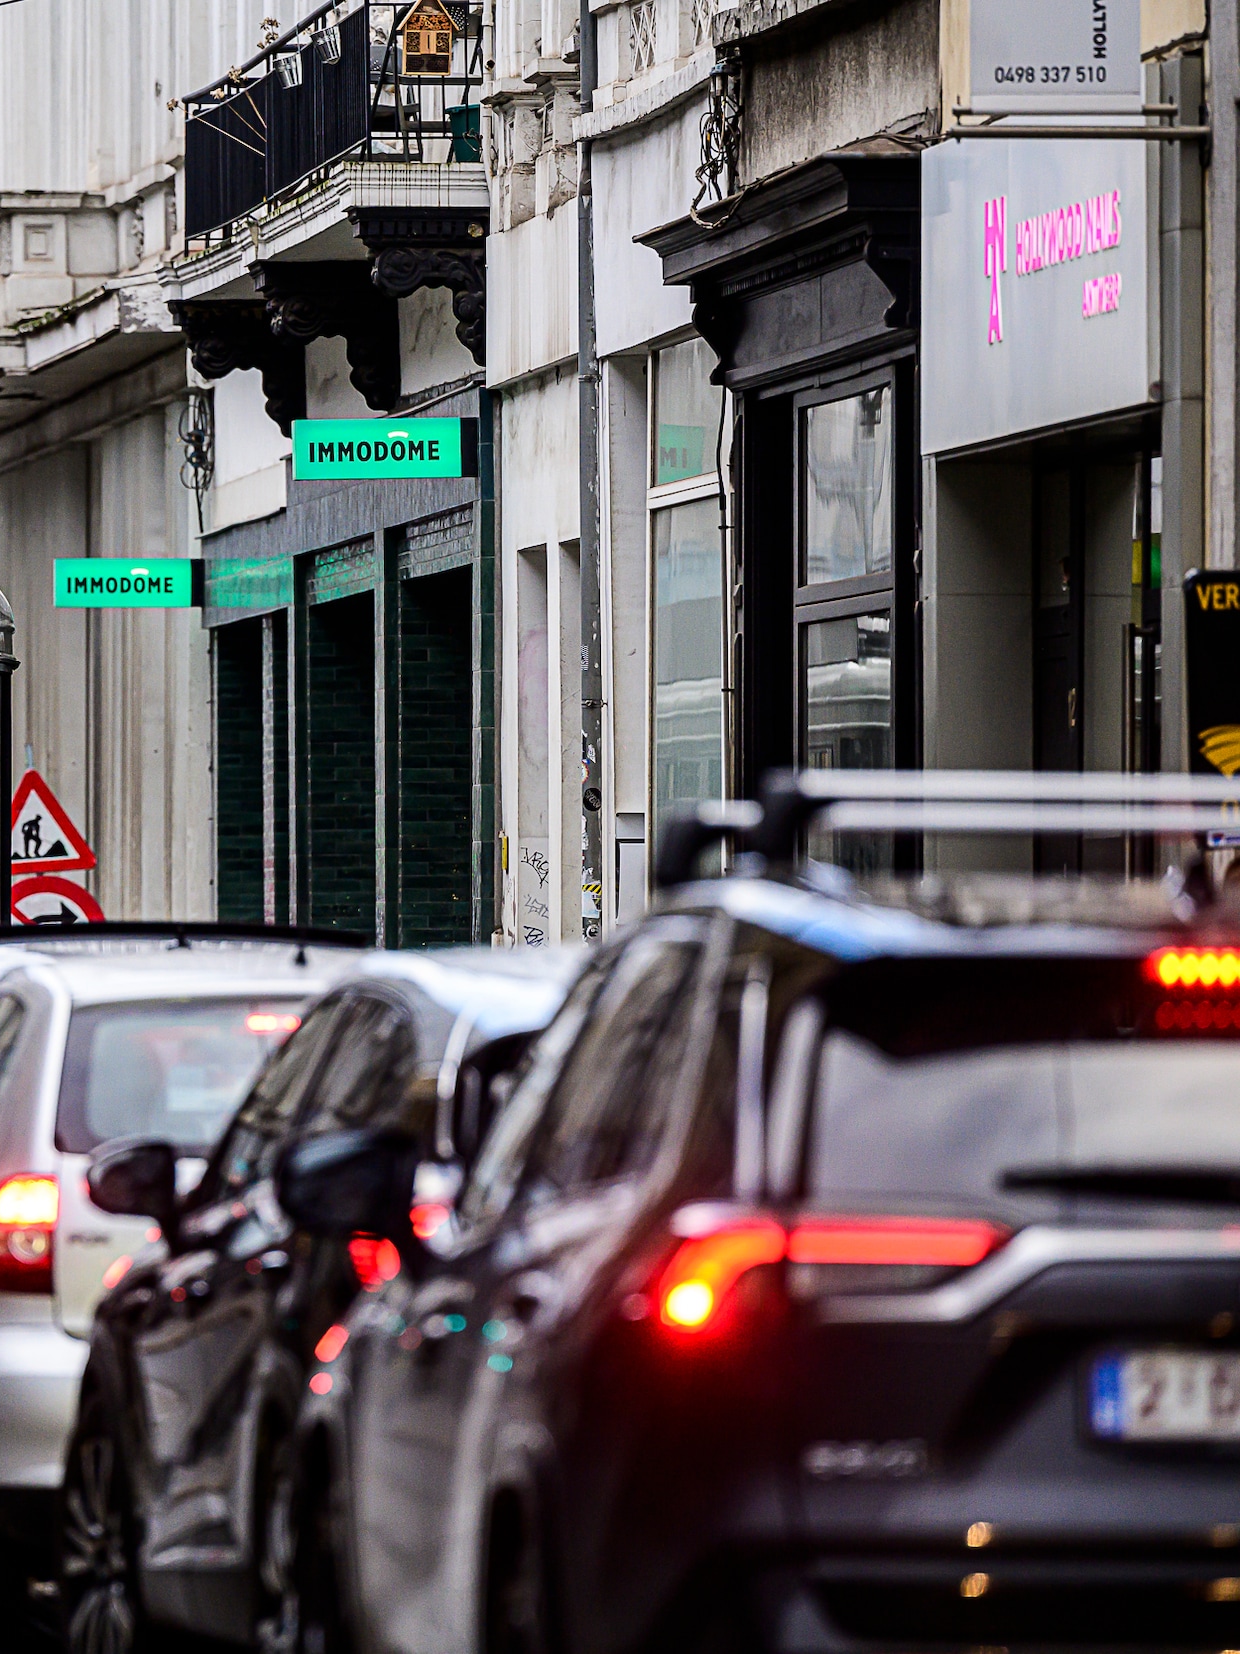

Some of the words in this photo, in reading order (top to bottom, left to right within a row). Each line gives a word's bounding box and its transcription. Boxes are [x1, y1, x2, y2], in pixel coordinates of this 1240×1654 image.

[994, 66, 1035, 83] 0498
[1040, 66, 1071, 83] 337
[1076, 66, 1107, 83] 510
[1016, 202, 1085, 277] HOLLYWOOD
[1085, 188, 1122, 254] NAILS
[1195, 583, 1239, 610] VER
